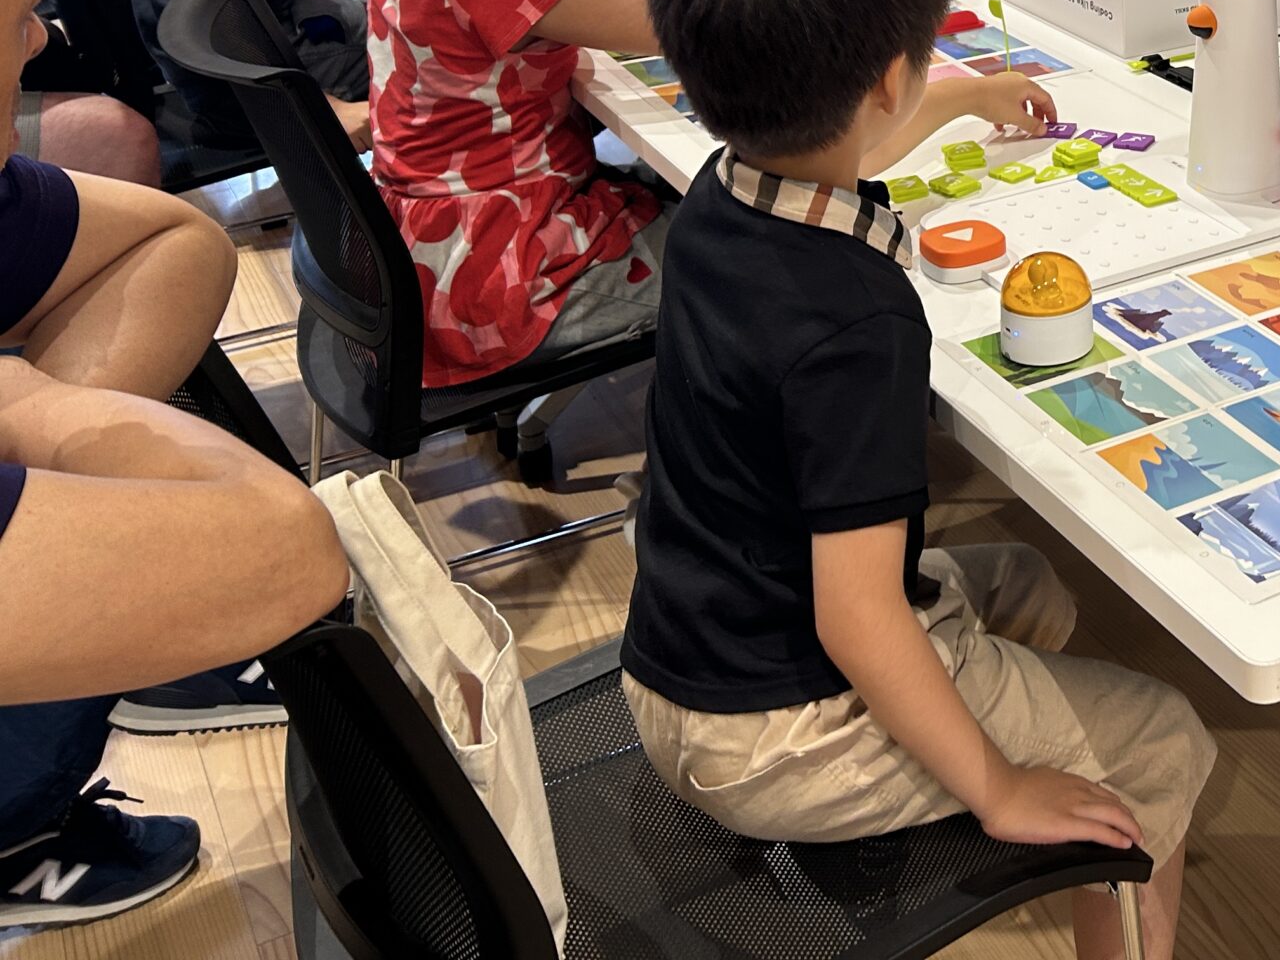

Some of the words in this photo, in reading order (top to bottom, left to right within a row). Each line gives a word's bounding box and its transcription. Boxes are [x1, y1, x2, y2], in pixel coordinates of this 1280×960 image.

[1089, 0, 1113, 21] Coding
[1174, 6, 1190, 14] SKILL
[10, 858, 91, 901] N
